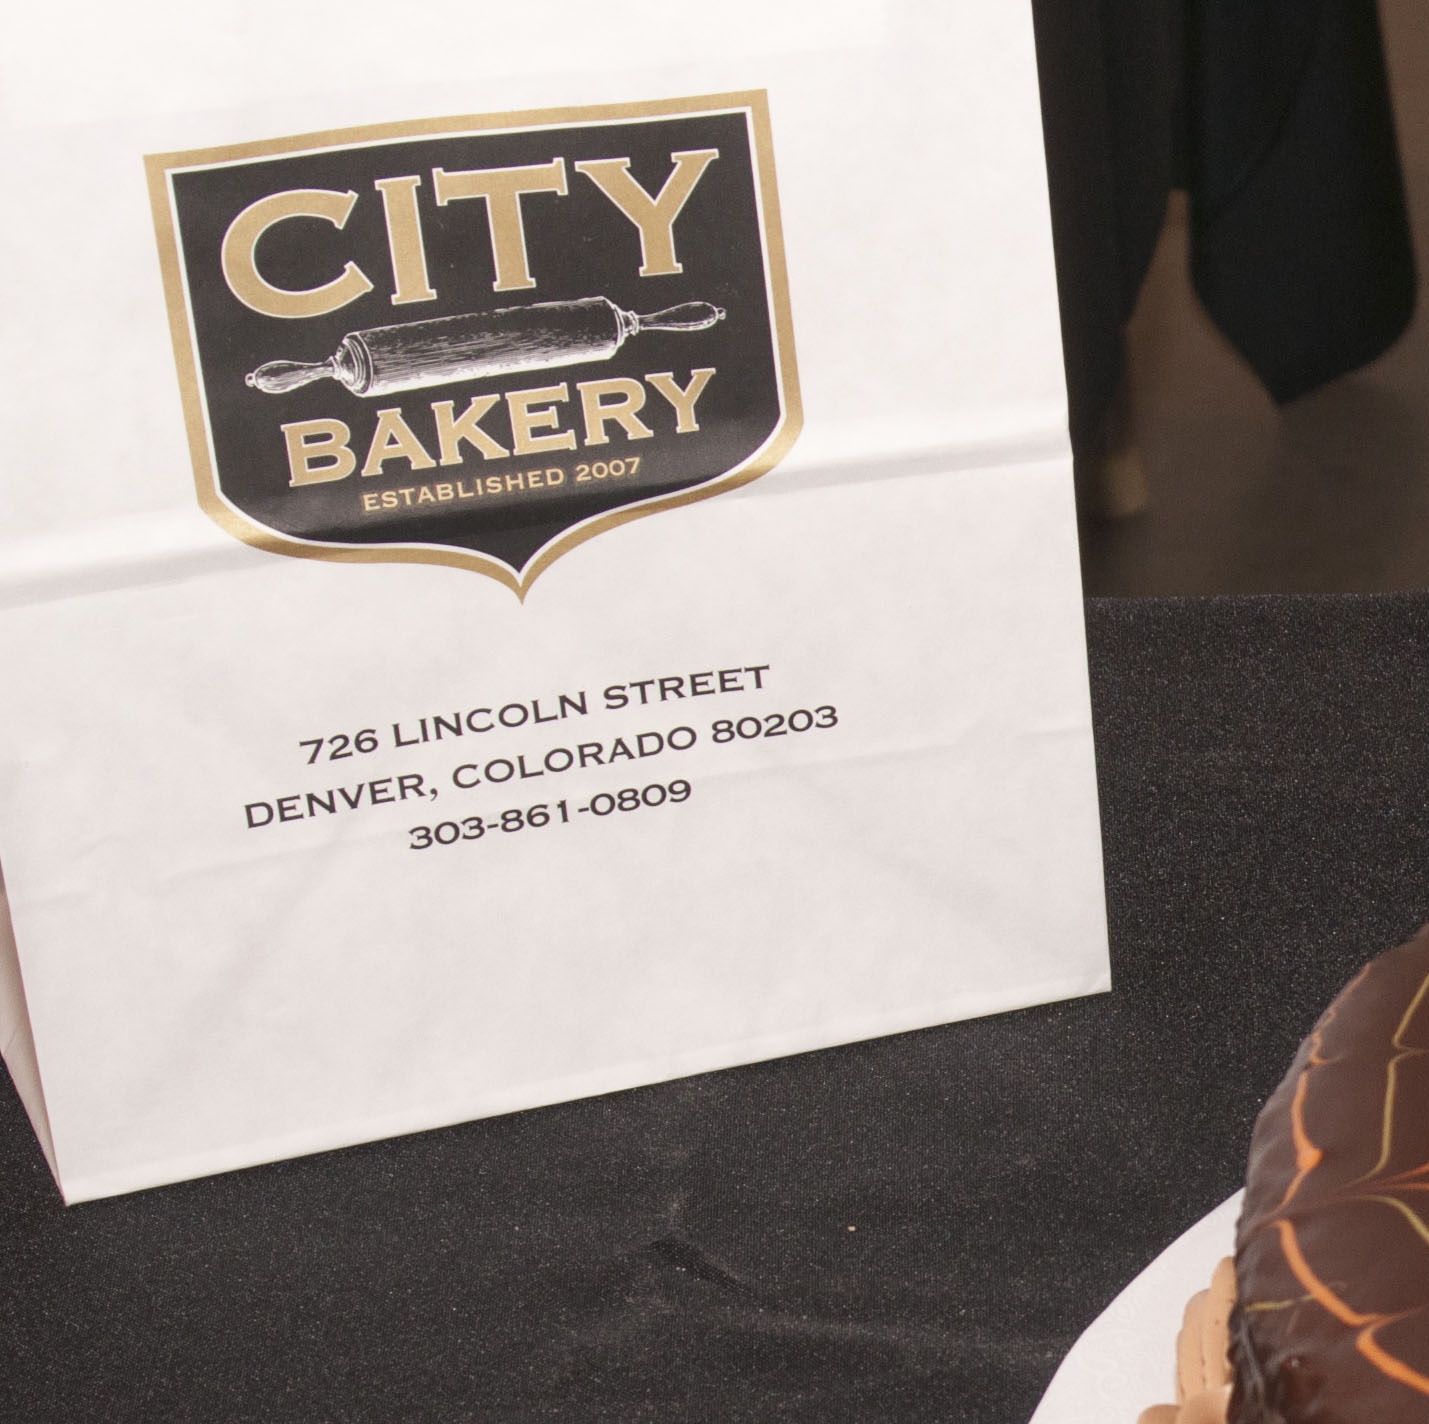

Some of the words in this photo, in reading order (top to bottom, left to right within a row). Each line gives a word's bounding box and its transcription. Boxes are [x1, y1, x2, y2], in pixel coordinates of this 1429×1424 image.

[220, 148, 720, 319] CITY
[280, 367, 717, 487] BAKERY
[362, 467, 566, 513] ESTABLISHED
[575, 456, 641, 484] 2007
[243, 773, 439, 829] DENVER,
[452, 726, 698, 789] COLORADO
[710, 705, 839, 744] 80203
[299, 728, 380, 765] 726
[391, 691, 589, 749] LINCOLN
[603, 664, 771, 710] STREET
[408, 778, 691, 849] 303-861-0809
